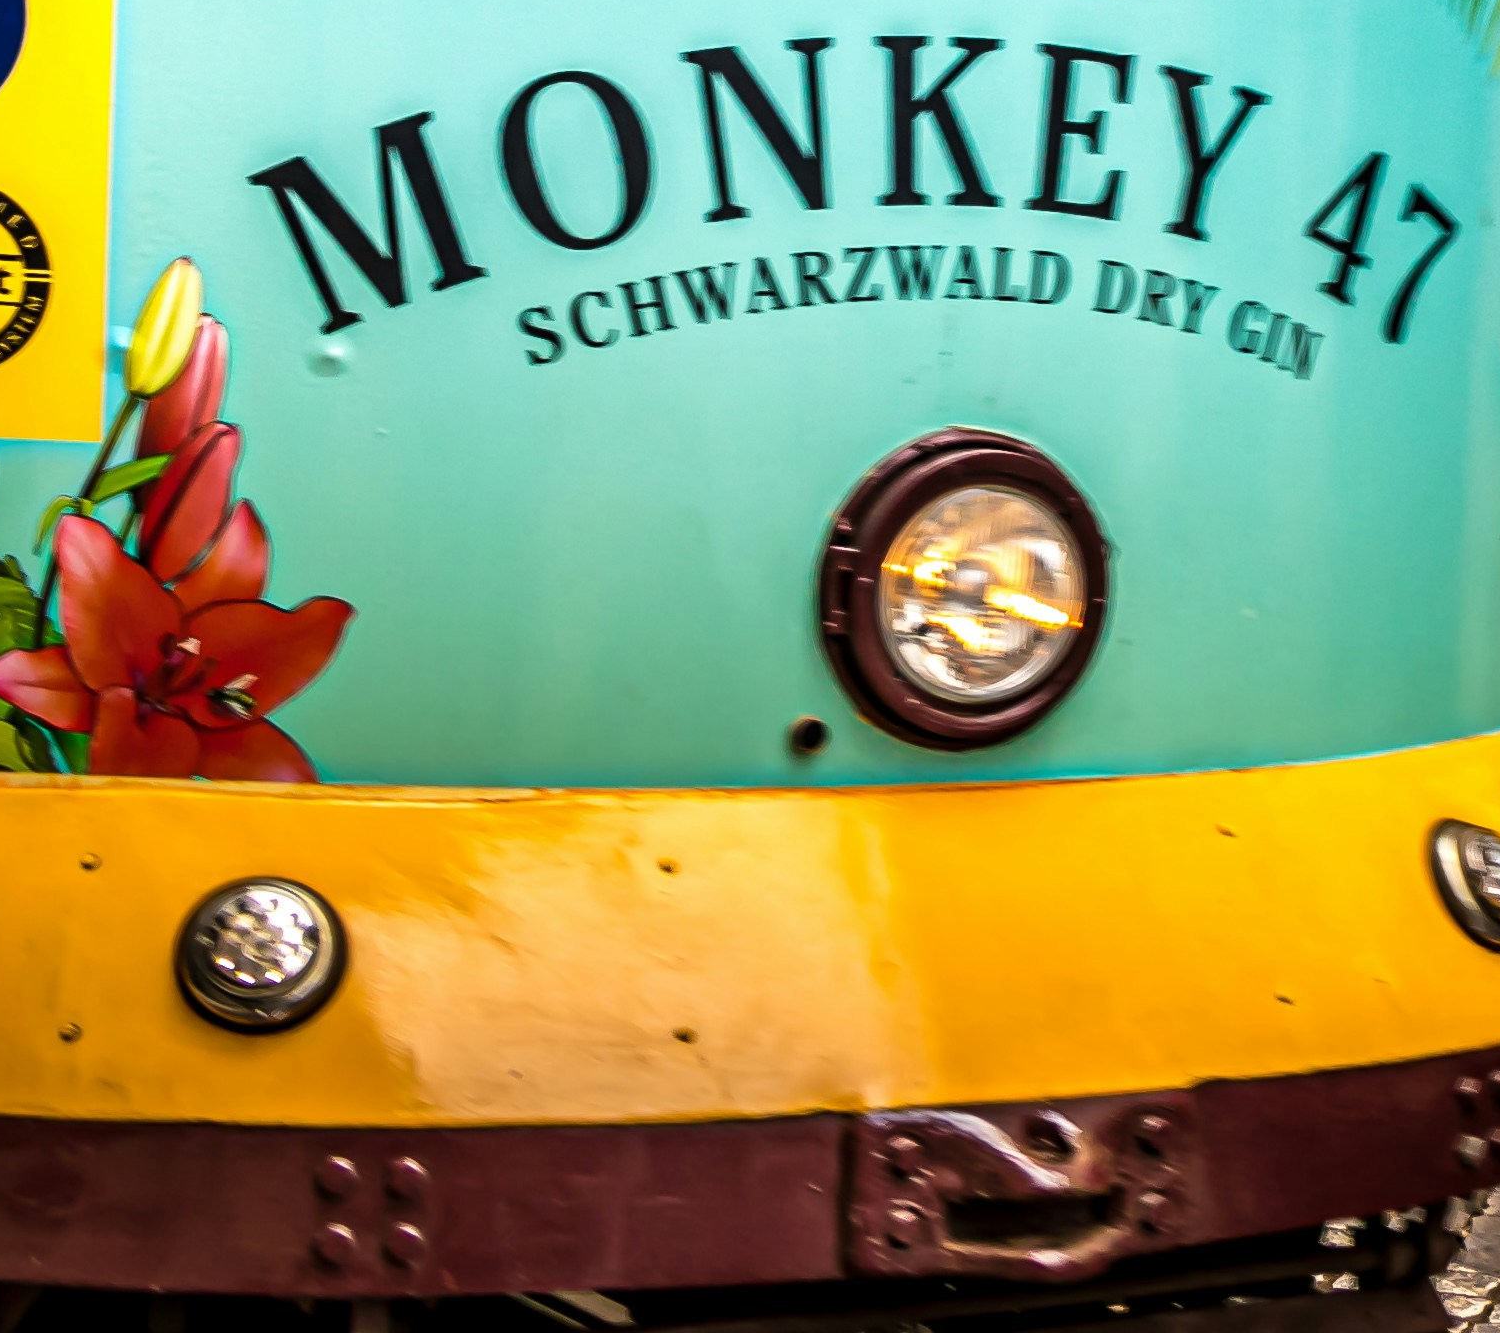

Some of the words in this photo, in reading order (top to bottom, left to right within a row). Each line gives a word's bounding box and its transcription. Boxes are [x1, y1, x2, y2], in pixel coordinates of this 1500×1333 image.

[247, 33, 1273, 336] MONKEY
[1301, 150, 1462, 345] 47
[513, 245, 1074, 367] SCHWARZWALD
[1089, 258, 1223, 334] DRY
[1225, 299, 1328, 381] GIN
